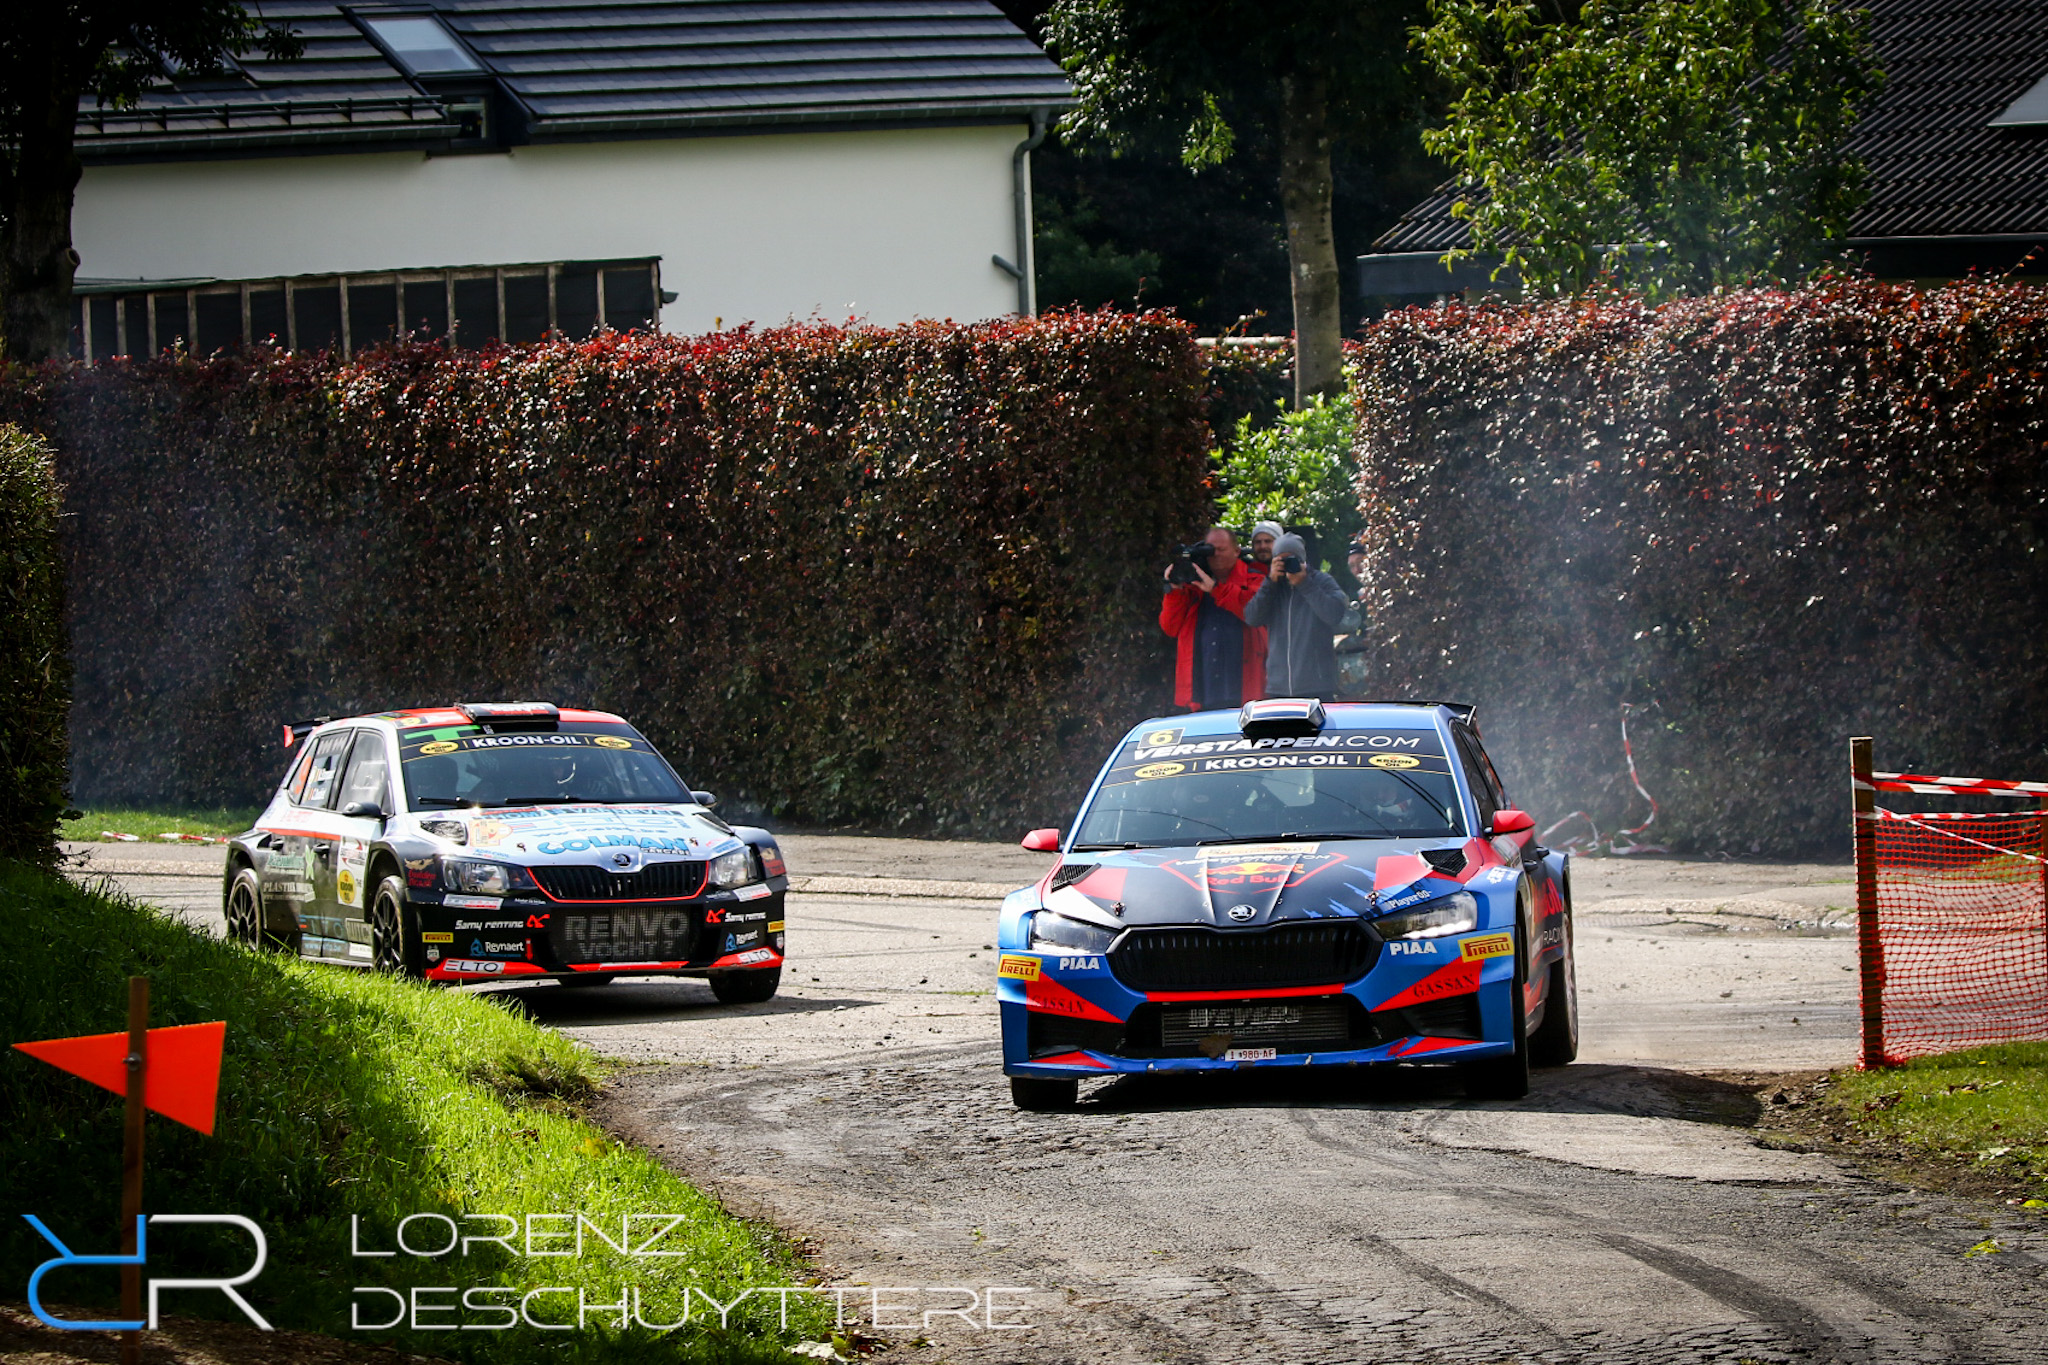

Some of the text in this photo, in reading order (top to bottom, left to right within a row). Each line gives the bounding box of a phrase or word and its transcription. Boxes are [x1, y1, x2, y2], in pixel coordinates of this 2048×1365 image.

[472, 735, 582, 748] KROON-OIL
[1148, 730, 1174, 747] 6
[1134, 736, 1421, 760] VERSTAPPEN.COM
[1142, 766, 1178, 774] KROON
[1204, 754, 1348, 771] KROON-OIL
[537, 834, 691, 855] COLMAN
[1207, 874, 1290, 886] Red Bull
[454, 919, 483, 931] Samy
[564, 911, 689, 941] RENVO
[484, 941, 525, 953] Reynaert
[1389, 941, 1438, 956] PIAA
[1463, 936, 1511, 957] PIRELLI
[445, 959, 499, 973] ELTO
[1000, 958, 1037, 977] PIRELLI
[1059, 957, 1100, 971] PIAA
[1413, 973, 1476, 998] GASSAN
